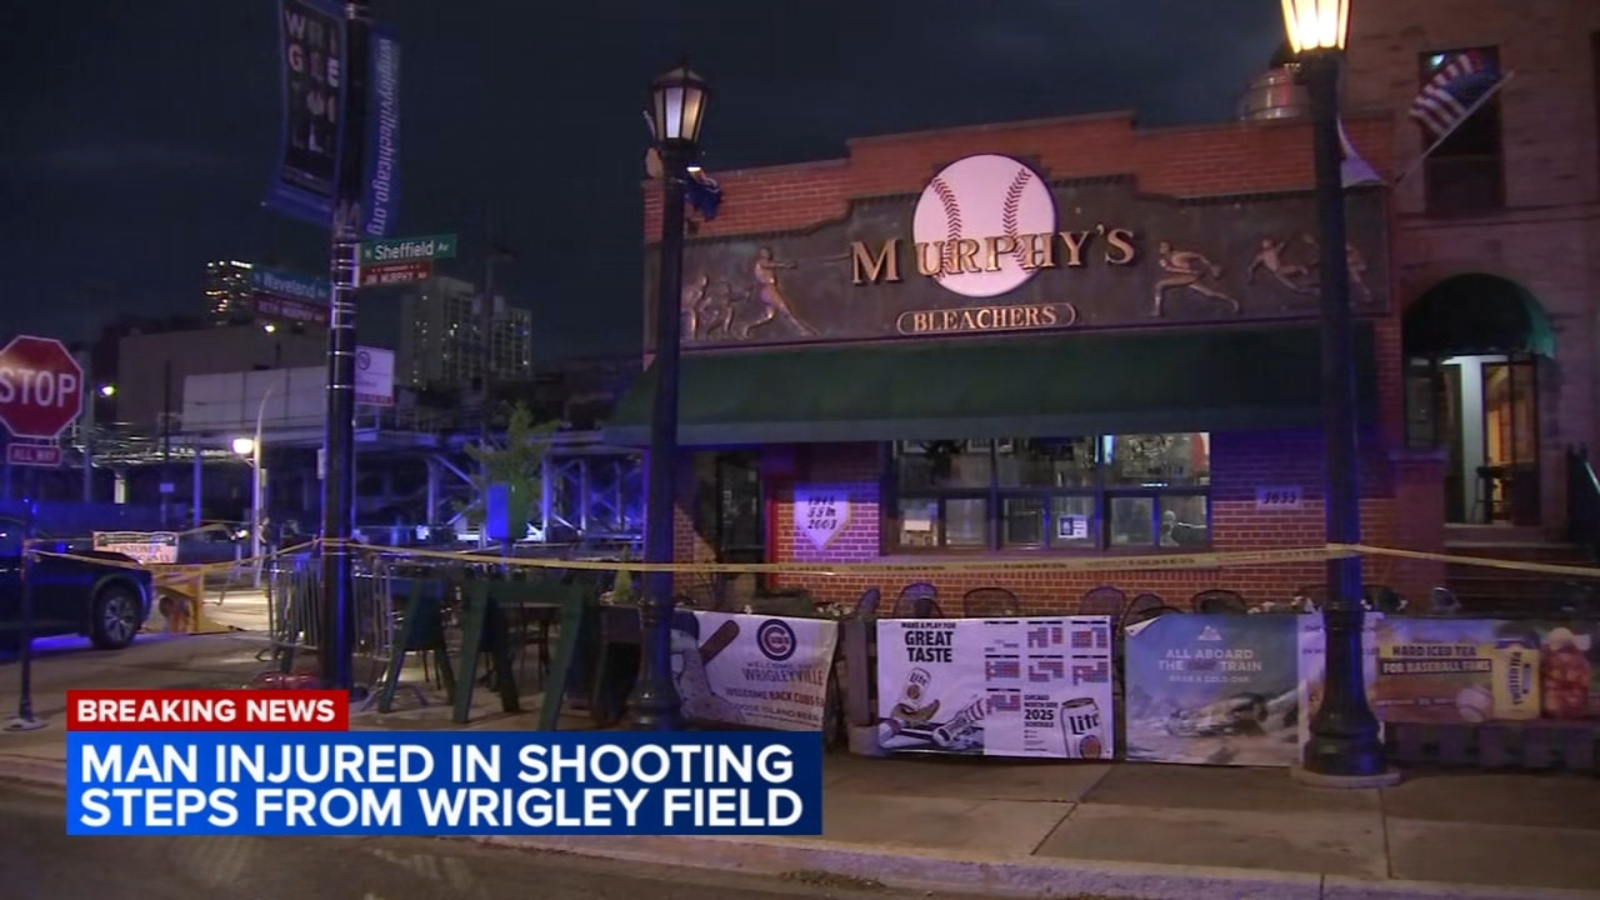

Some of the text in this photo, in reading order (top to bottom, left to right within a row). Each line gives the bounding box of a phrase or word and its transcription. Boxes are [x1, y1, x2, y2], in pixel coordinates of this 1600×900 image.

[374, 240, 434, 260] Sheffield
[852, 224, 1135, 285] MURPHY'S
[263, 272, 316, 299] Waveland
[913, 305, 1057, 333] BLEACHERS
[0, 369, 76, 408] STOP
[904, 630, 955, 646] GREAT
[906, 647, 953, 663] TASTE
[1165, 649, 1254, 660] ALL ABOARD
[1392, 645, 1425, 656] HARD
[1427, 645, 1452, 656] ICED
[1159, 660, 1184, 671] THE
[1219, 661, 1262, 672] TRAIN
[742, 667, 824, 686] WRIGLEYVILLE
[725, 687, 767, 700] WELCOME
[769, 690, 793, 701] BACK
[1024, 708, 1054, 721] 2025
